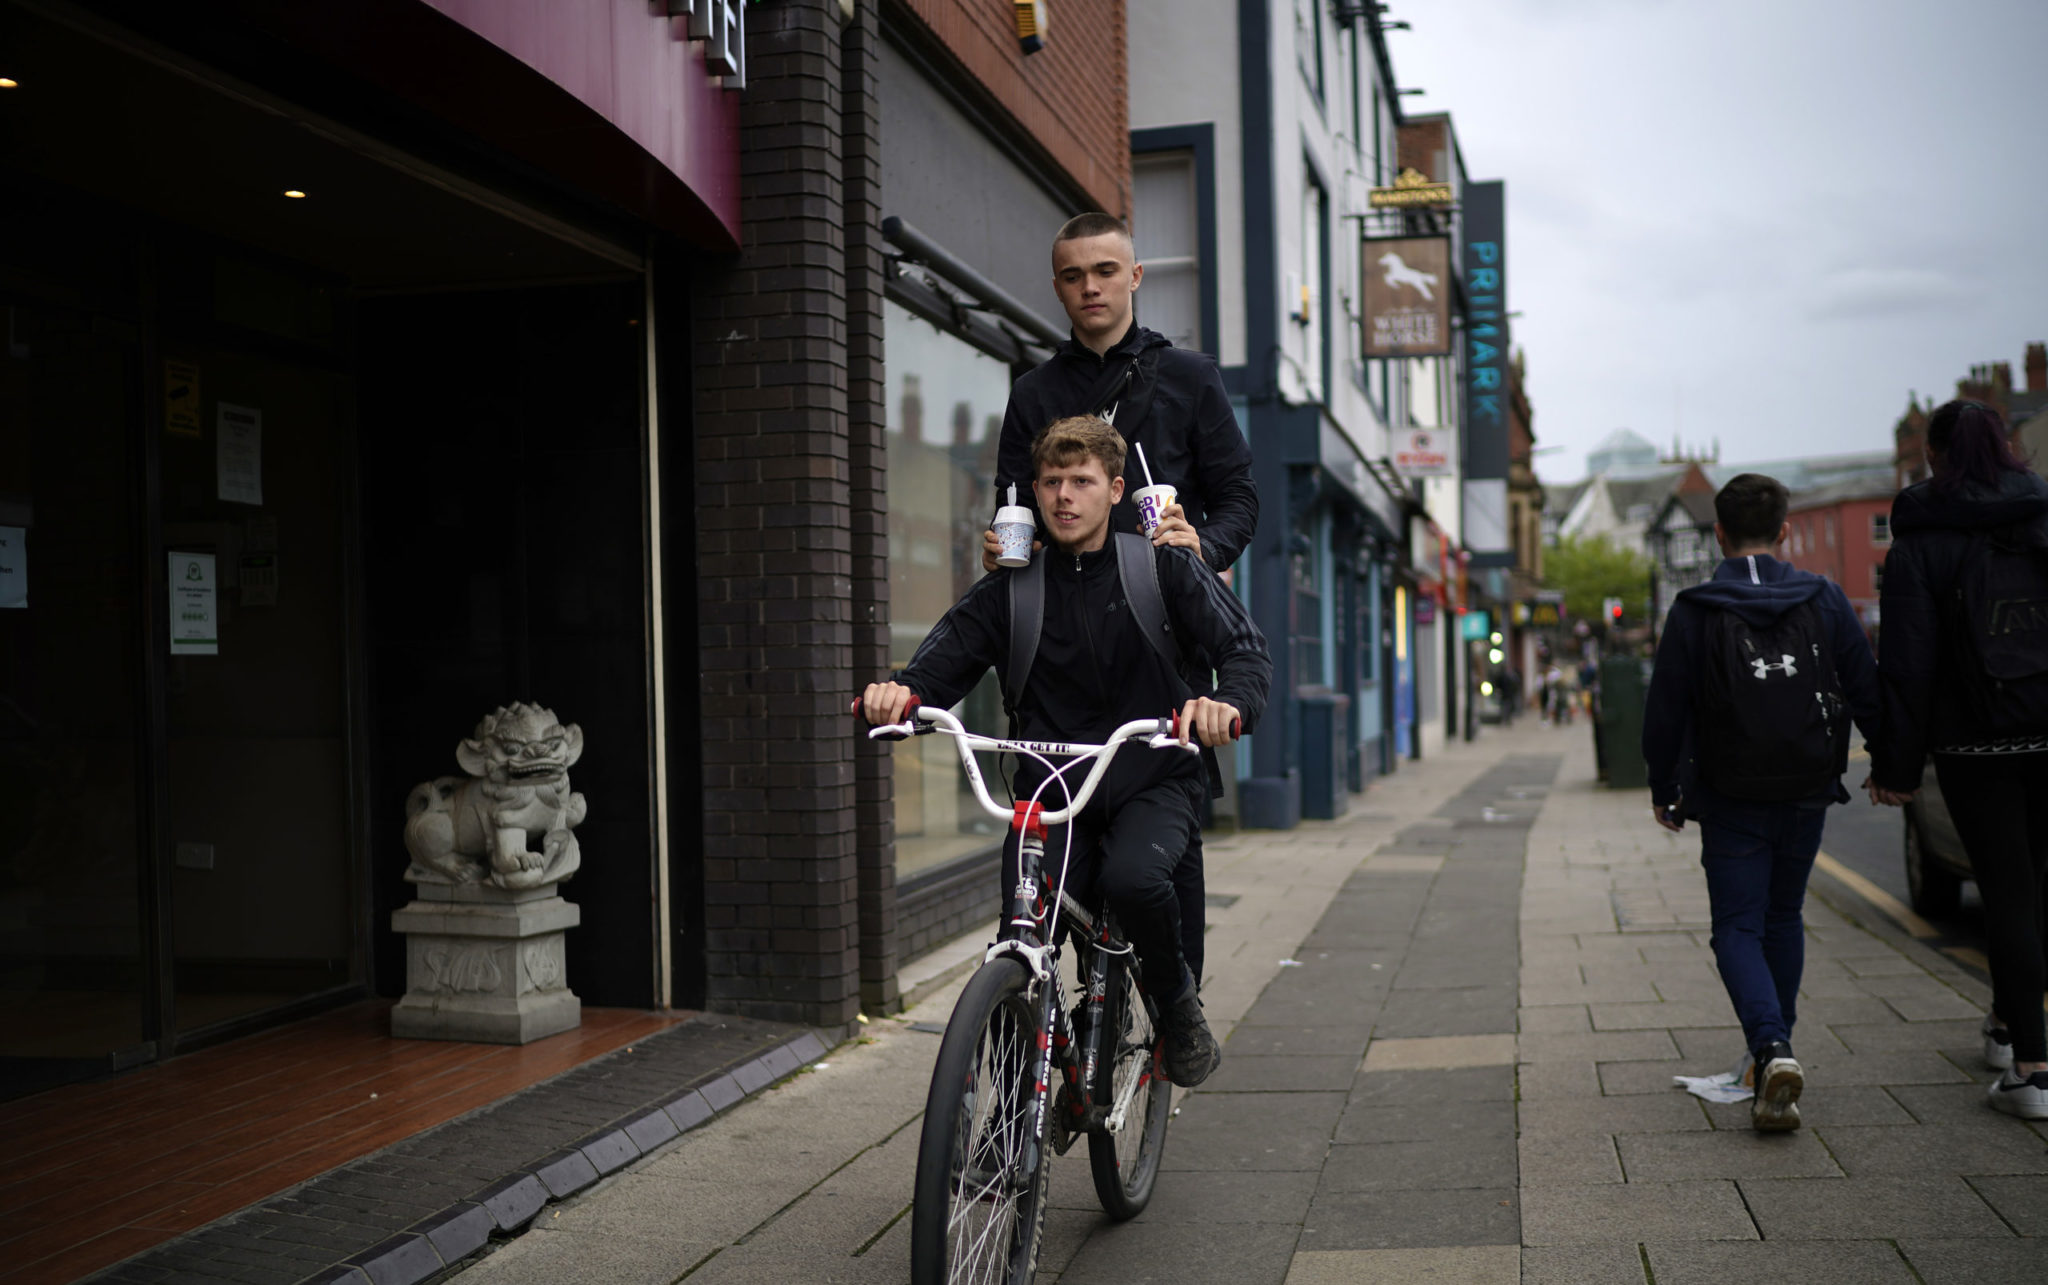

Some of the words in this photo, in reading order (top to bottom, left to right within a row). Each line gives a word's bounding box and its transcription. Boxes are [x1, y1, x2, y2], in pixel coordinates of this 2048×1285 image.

[1373, 314, 1438, 330] WHITE
[1373, 330, 1438, 346] HORSE
[1469, 241, 1500, 427] PRIMARK
[1030, 742, 1051, 752] GET
